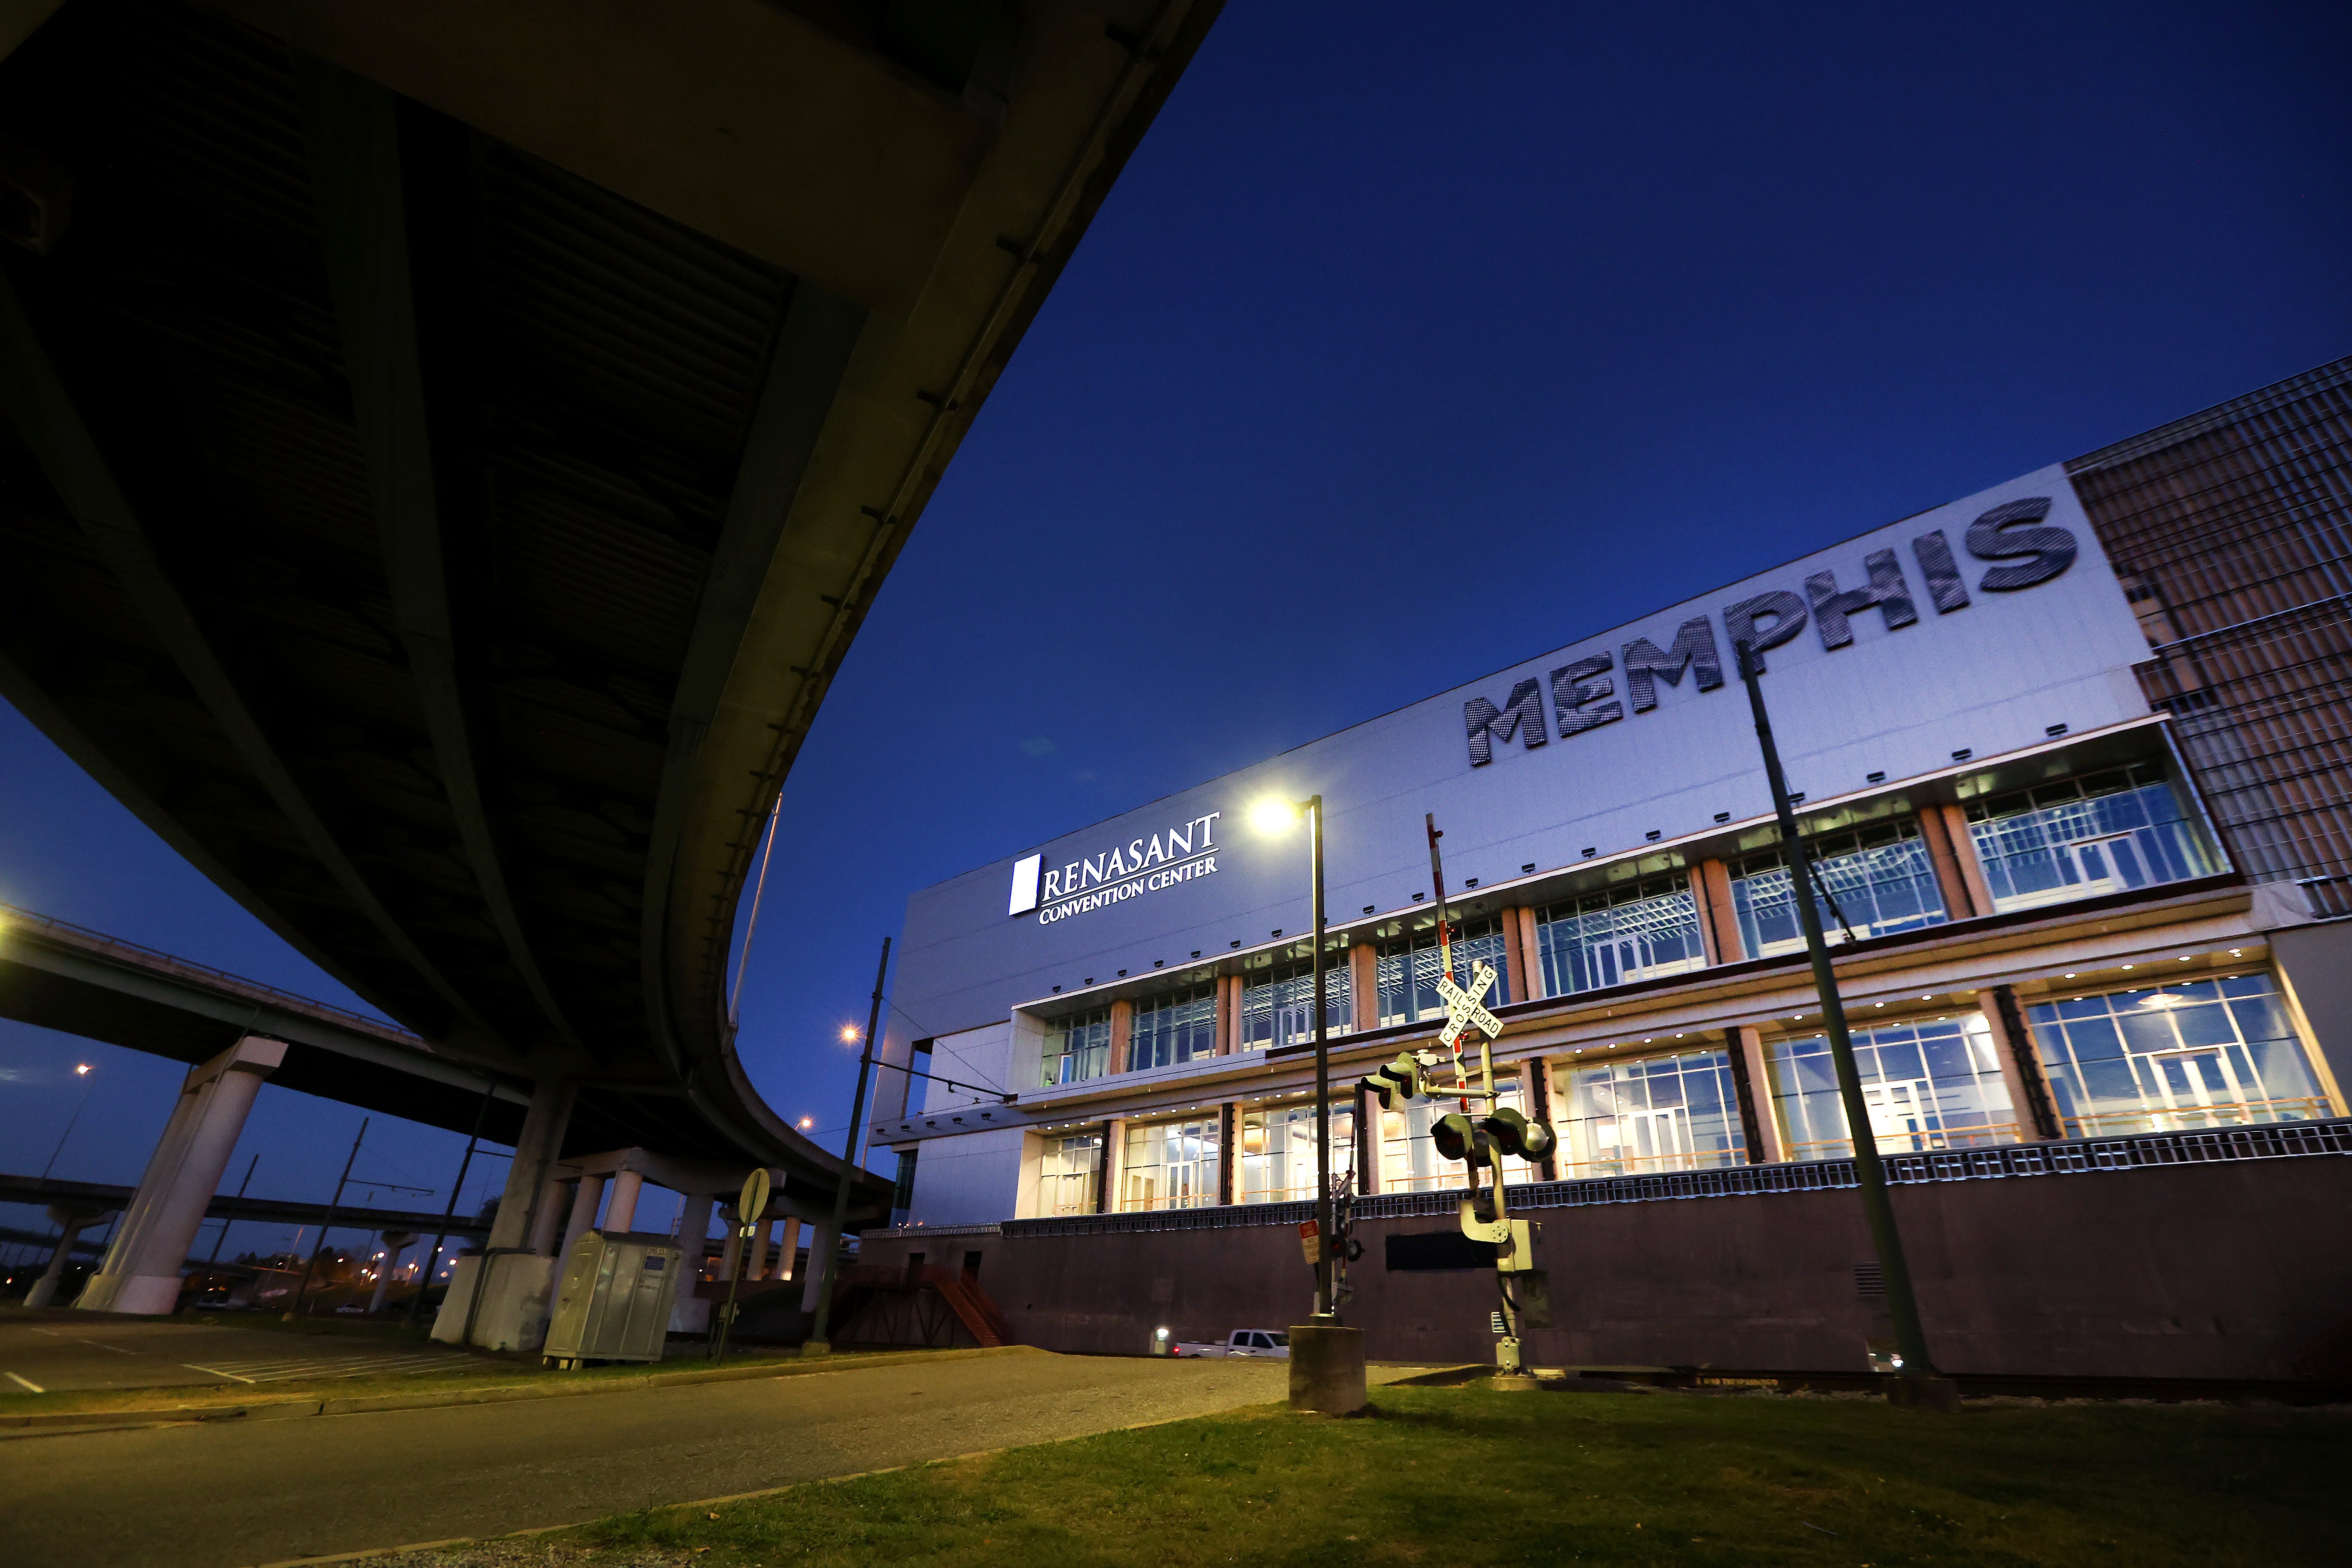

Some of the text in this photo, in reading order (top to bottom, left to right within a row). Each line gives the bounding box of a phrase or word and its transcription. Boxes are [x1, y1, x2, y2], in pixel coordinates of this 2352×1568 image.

[1464, 497, 2077, 767] MEMPHIS
[1038, 857, 1218, 925] CONVENTION CENTER
[1042, 811, 1220, 901] RENASANT
[1444, 969, 1493, 1042] CROSSING
